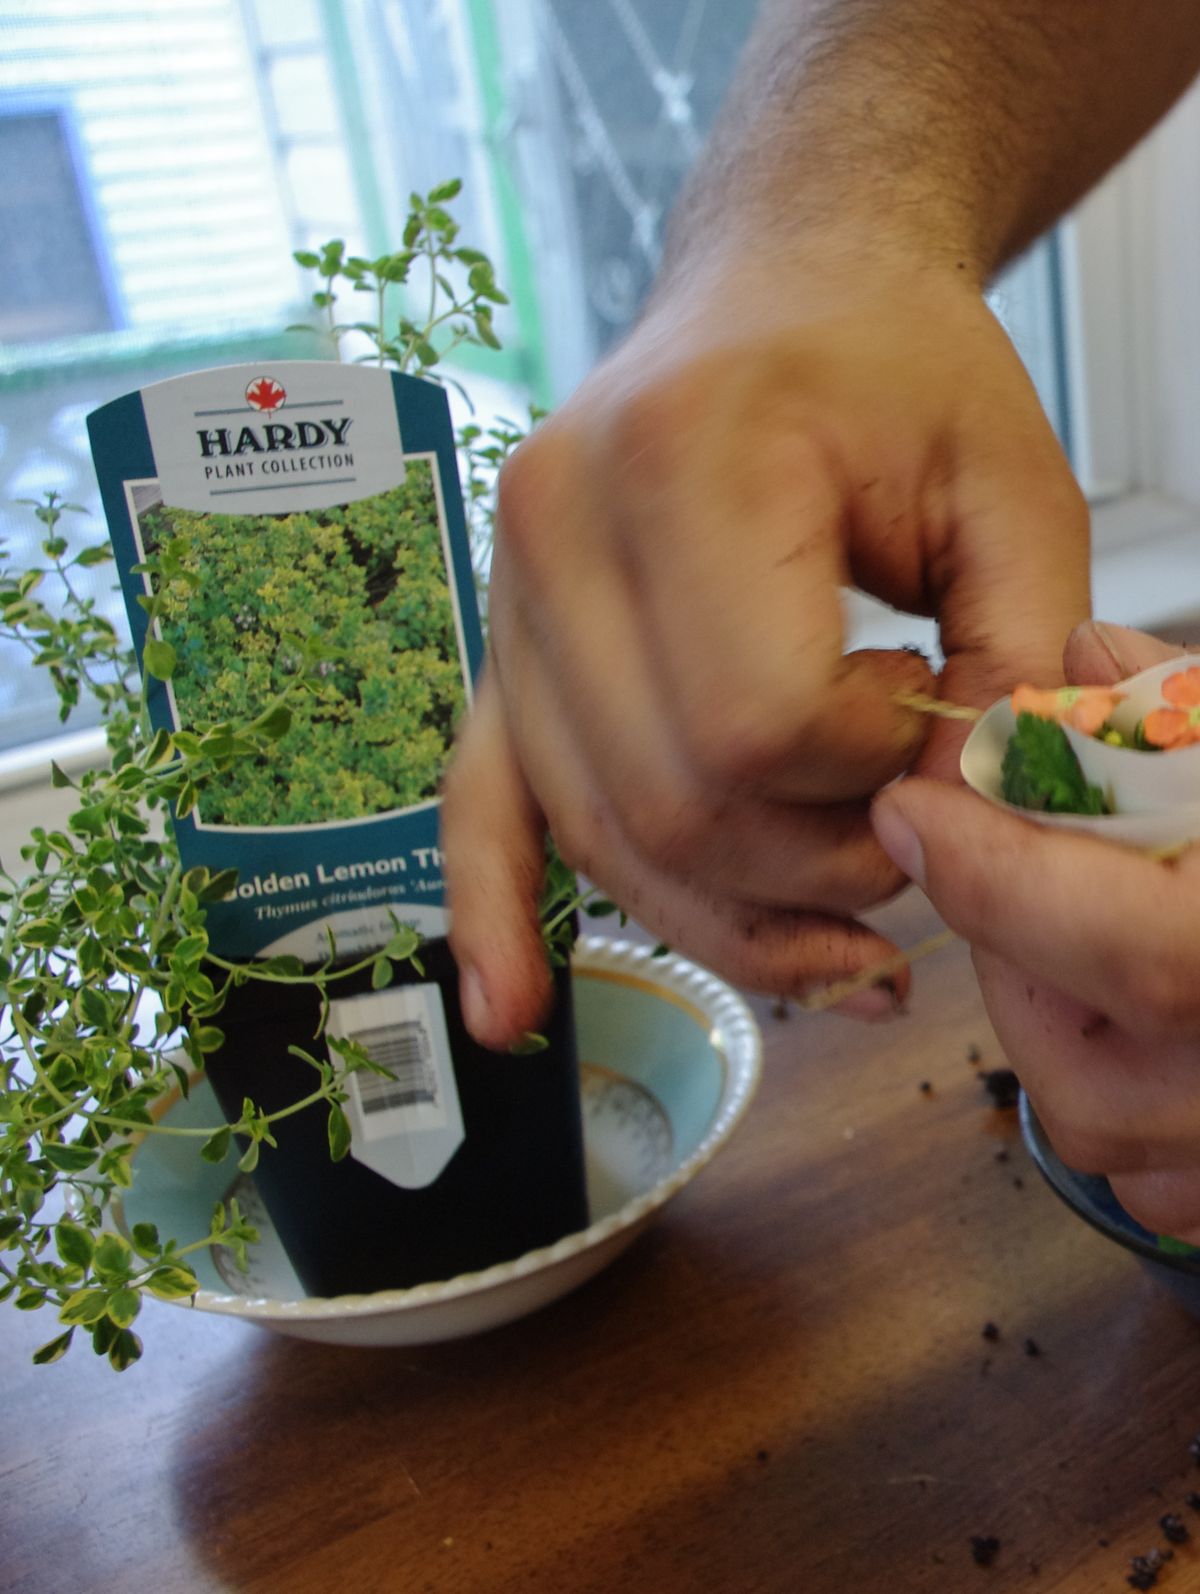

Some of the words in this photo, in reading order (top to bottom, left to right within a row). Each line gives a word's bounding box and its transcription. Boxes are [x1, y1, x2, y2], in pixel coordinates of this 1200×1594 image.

[197, 418, 353, 458] HARDY
[205, 462, 255, 480] PLANT
[261, 453, 354, 475] COLLECTION
[316, 856, 407, 885] Lemon
[255, 899, 318, 921] Thymus
